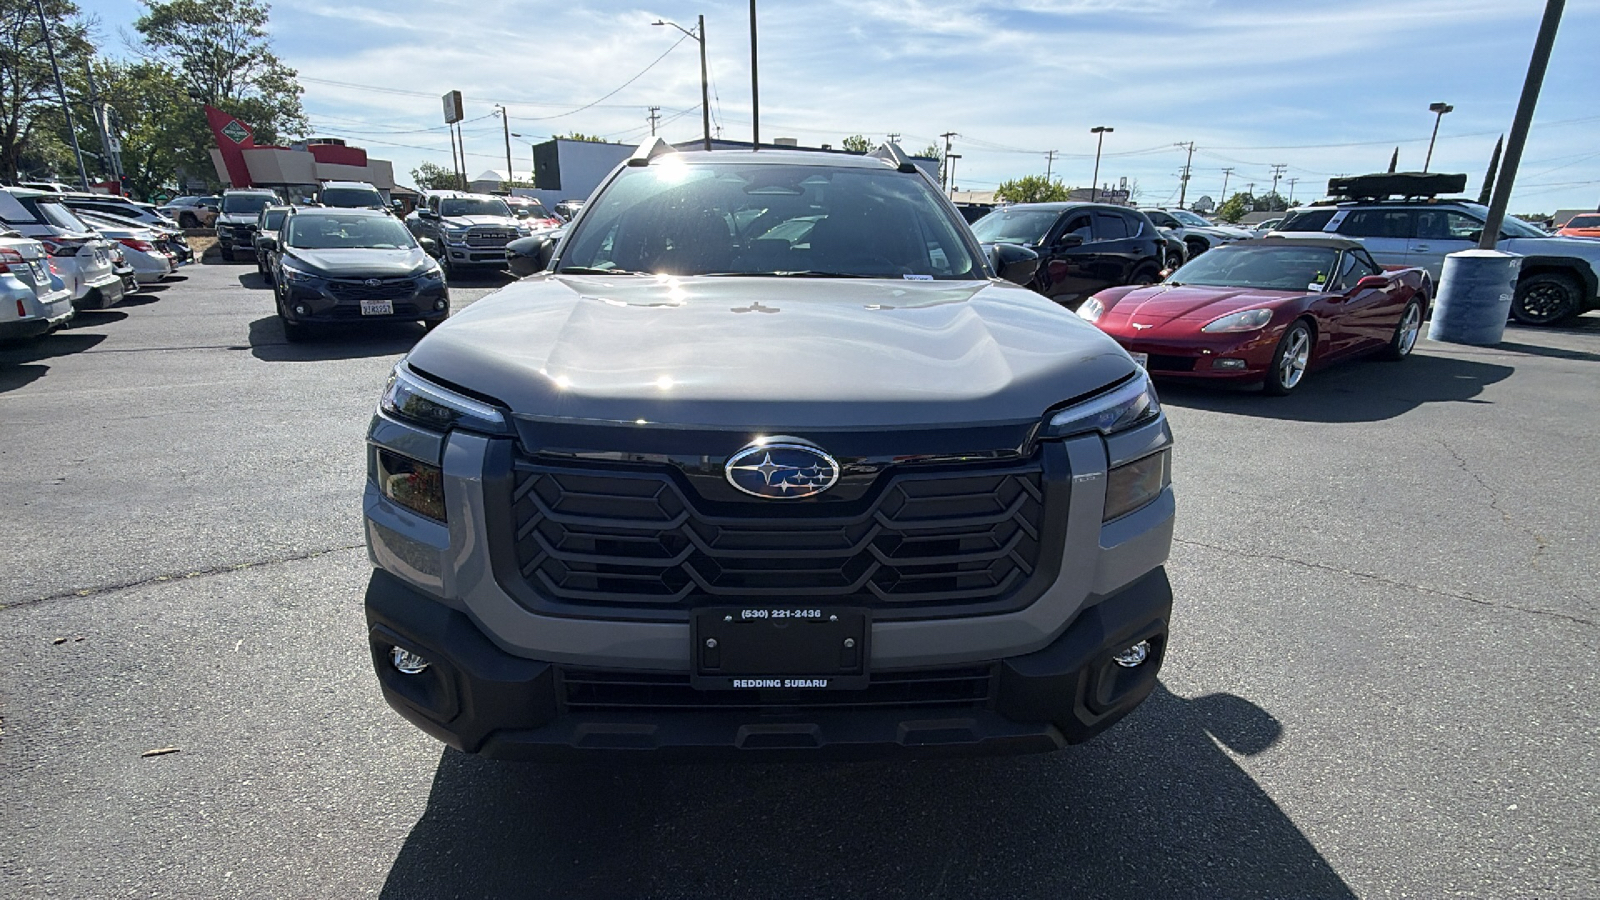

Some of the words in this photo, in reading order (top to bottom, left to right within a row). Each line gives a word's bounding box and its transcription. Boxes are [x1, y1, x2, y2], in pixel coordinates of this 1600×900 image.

[741, 609, 769, 619] (530)
[771, 609, 821, 618] 221-2436
[733, 679, 781, 688] REDDING
[784, 679, 828, 688] SUBARU
